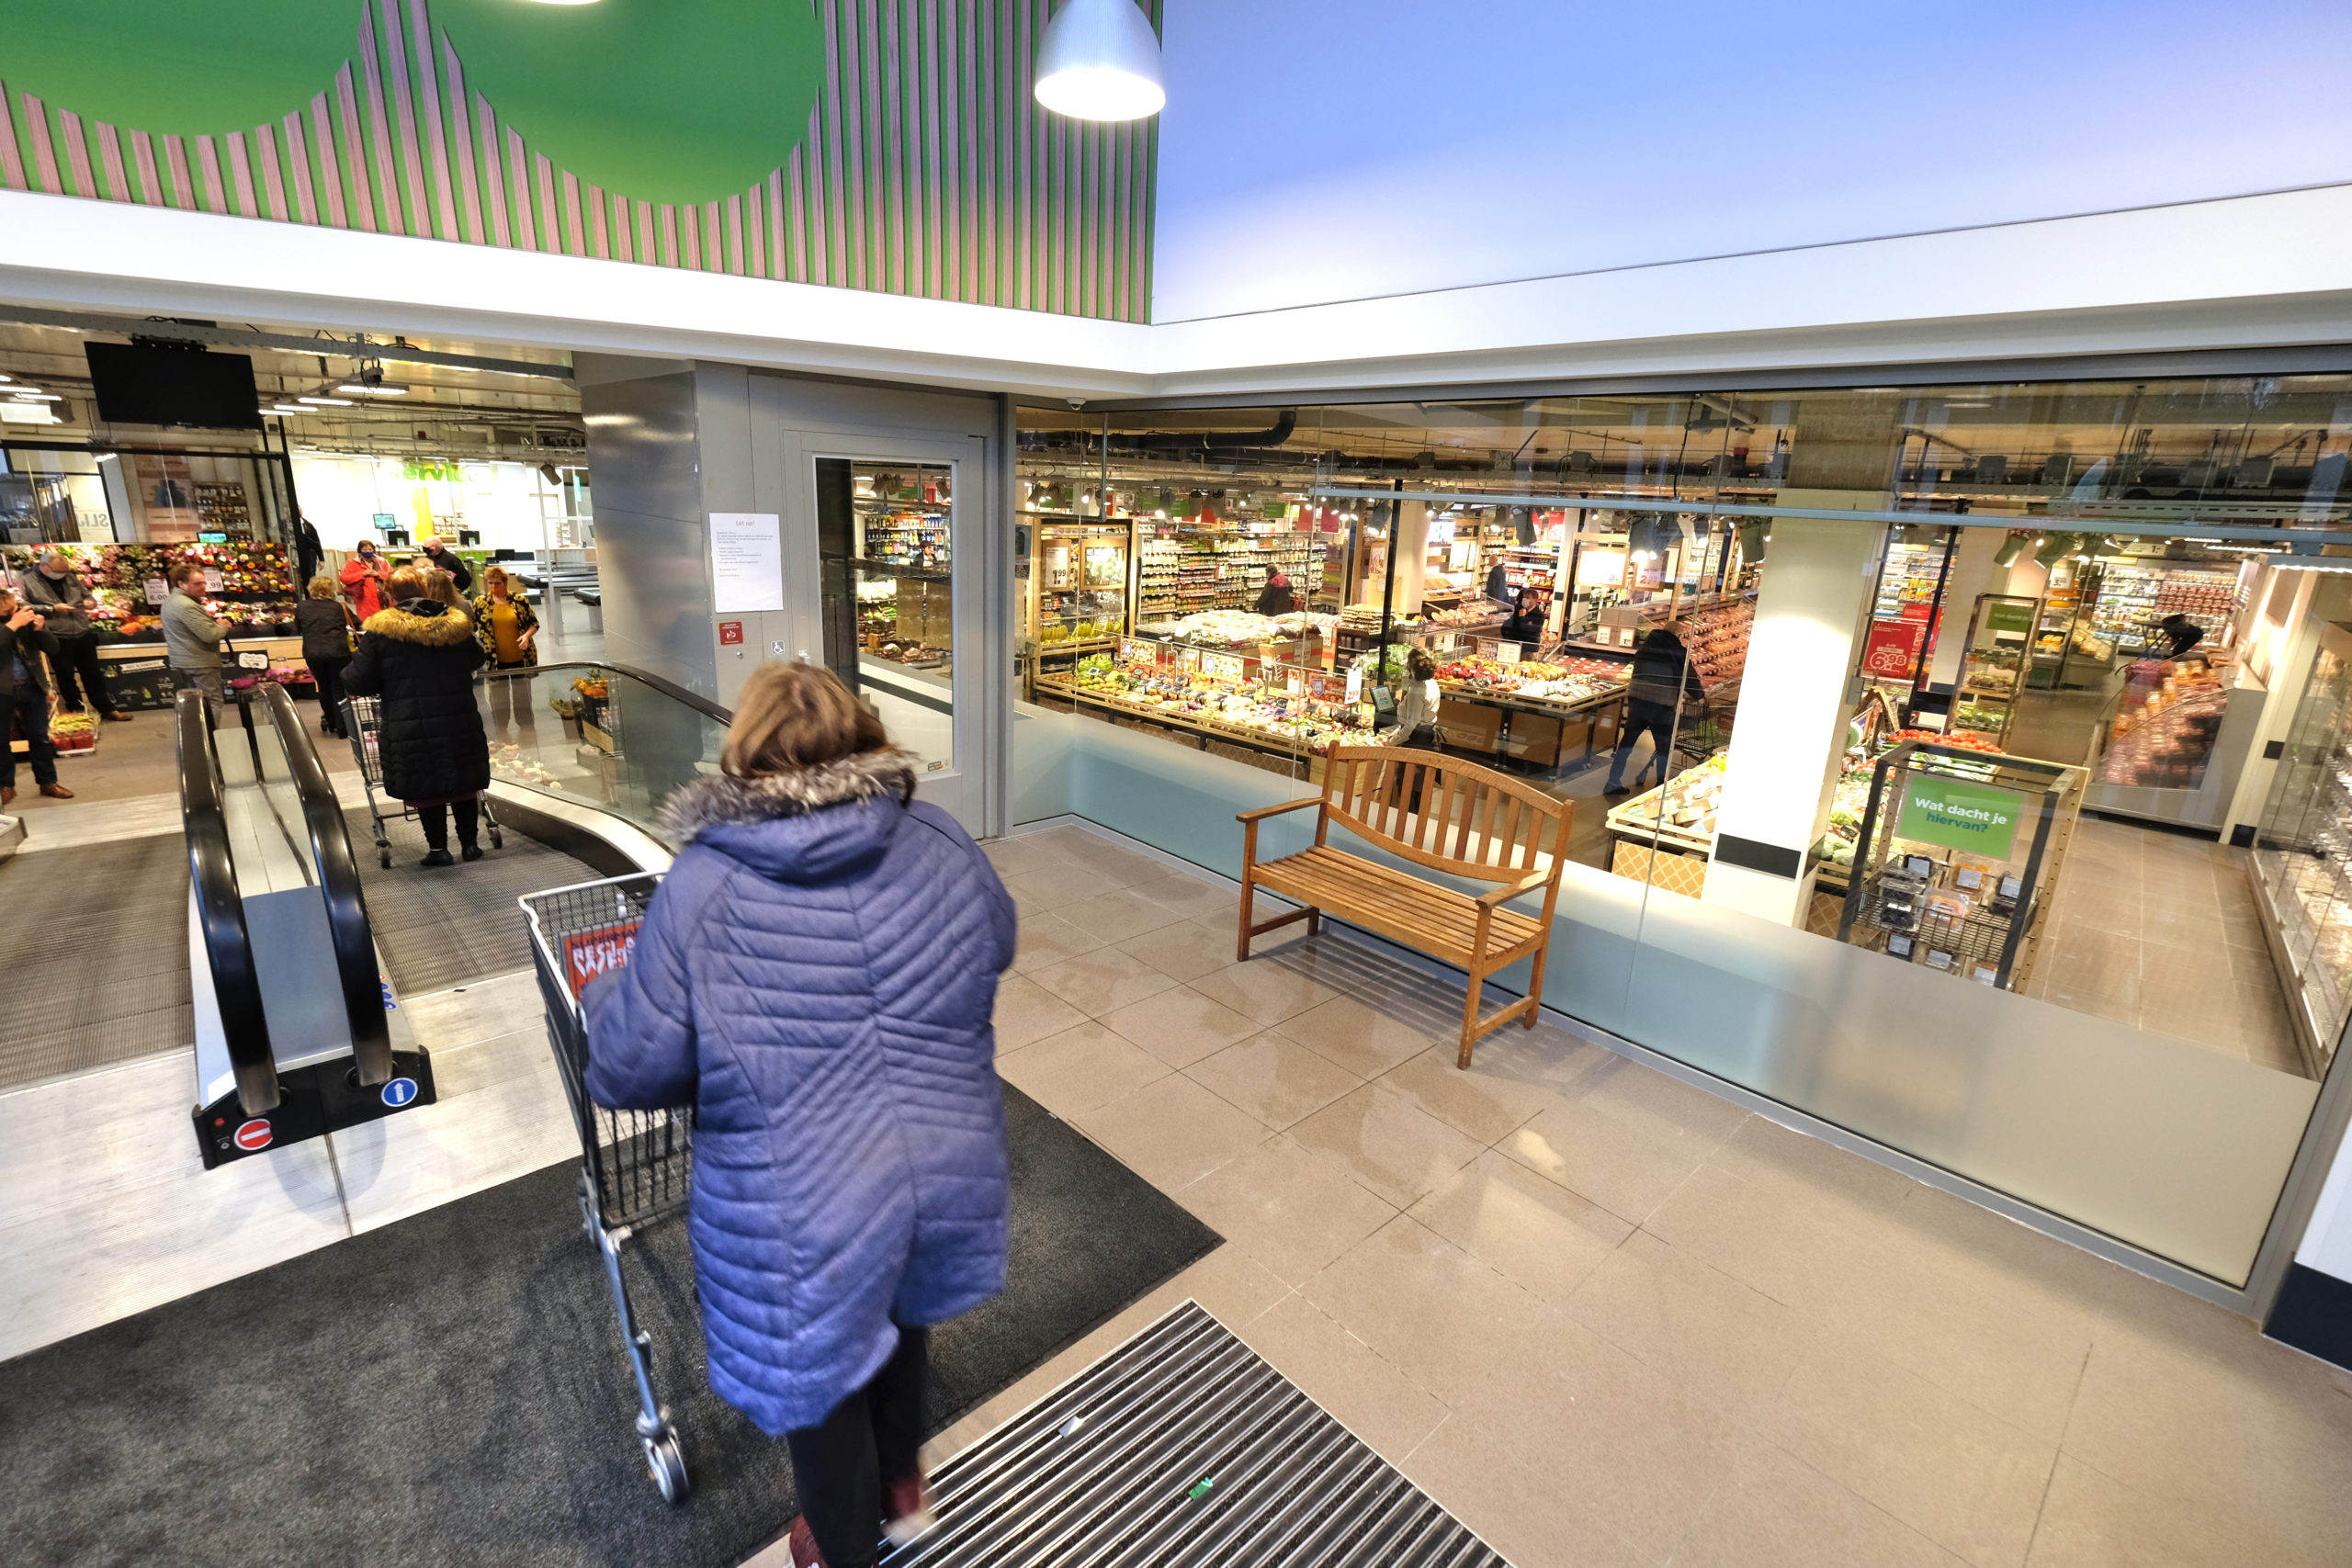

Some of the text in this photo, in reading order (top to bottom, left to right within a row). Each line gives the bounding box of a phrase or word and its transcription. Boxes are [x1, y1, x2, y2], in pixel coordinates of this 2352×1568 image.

[1052, 569, 1067, 585] 1.99
[1870, 651, 1907, 670] 6.98
[1915, 797, 2007, 825] Wat dacht je
[1926, 812, 1989, 833] hiervan?
